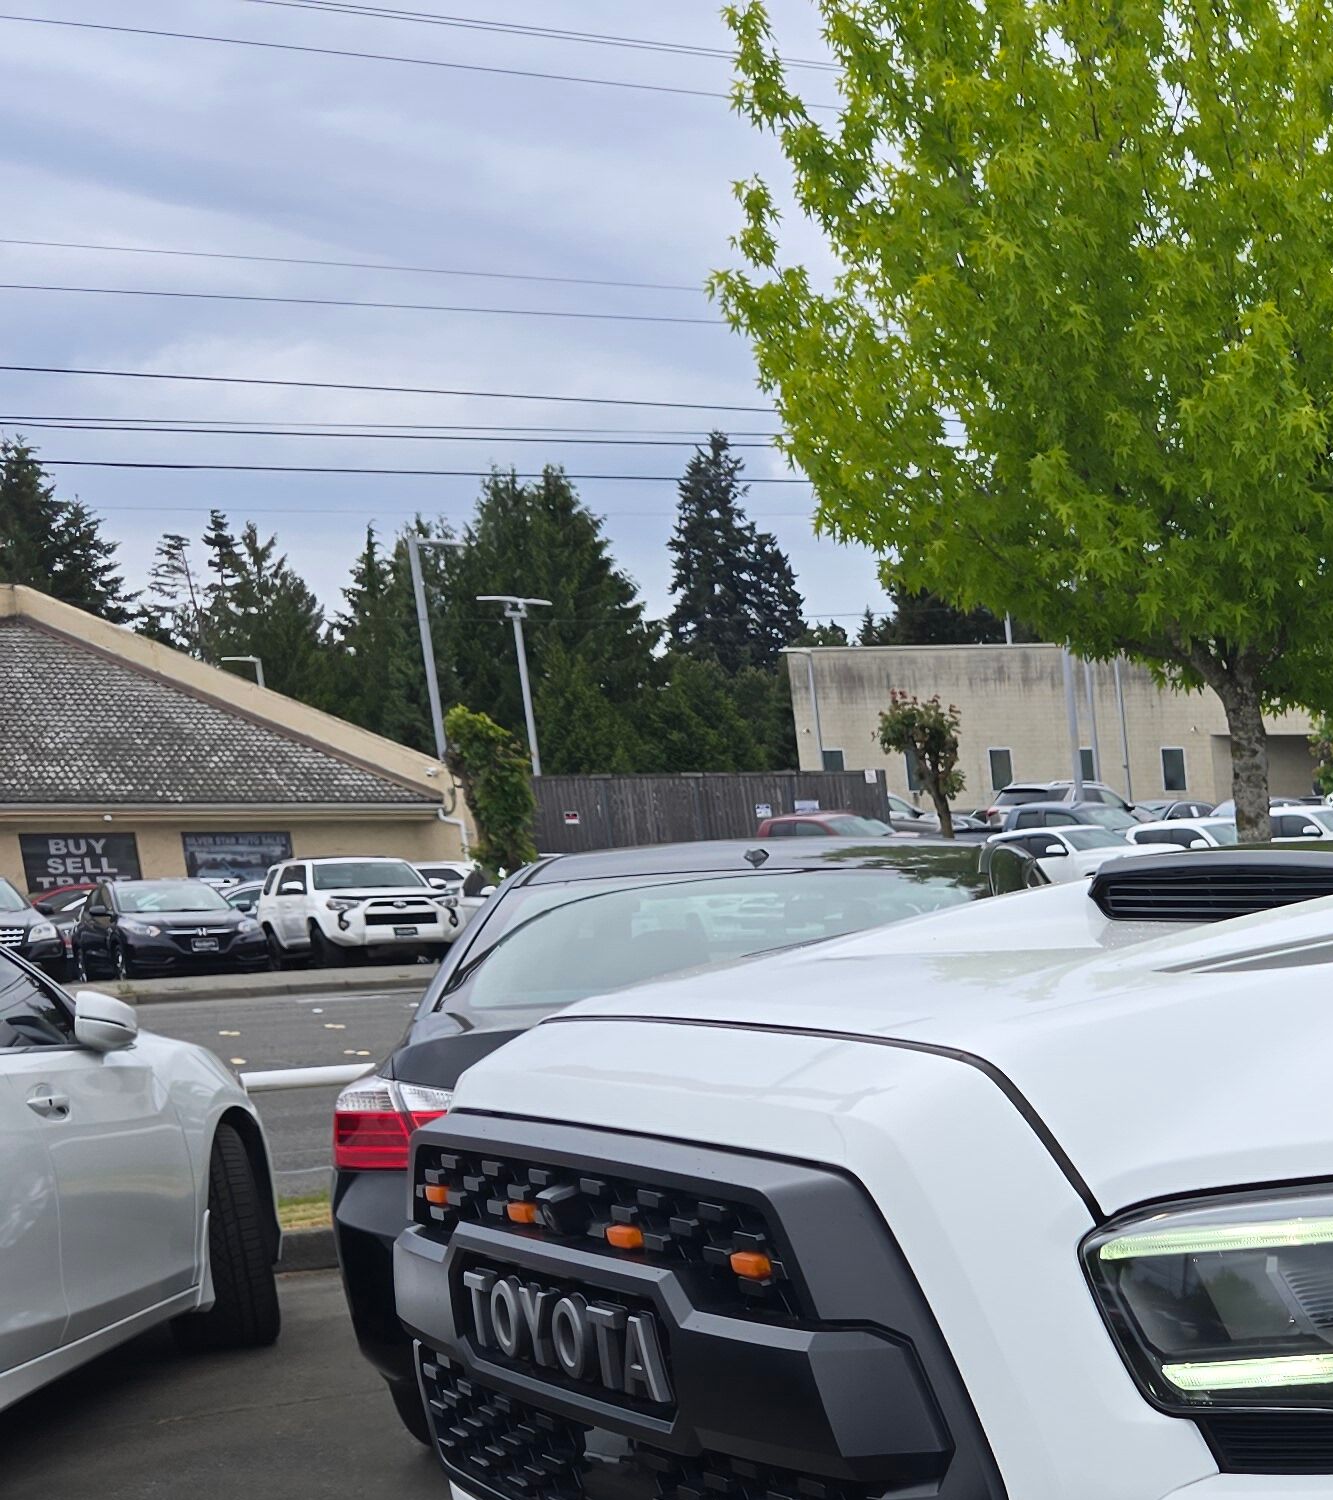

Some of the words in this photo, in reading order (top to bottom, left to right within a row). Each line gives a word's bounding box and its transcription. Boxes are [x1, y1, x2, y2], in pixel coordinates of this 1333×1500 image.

[48, 839, 106, 855] BUY
[47, 857, 118, 874] SELL
[463, 1268, 675, 1403] TOYOTA
